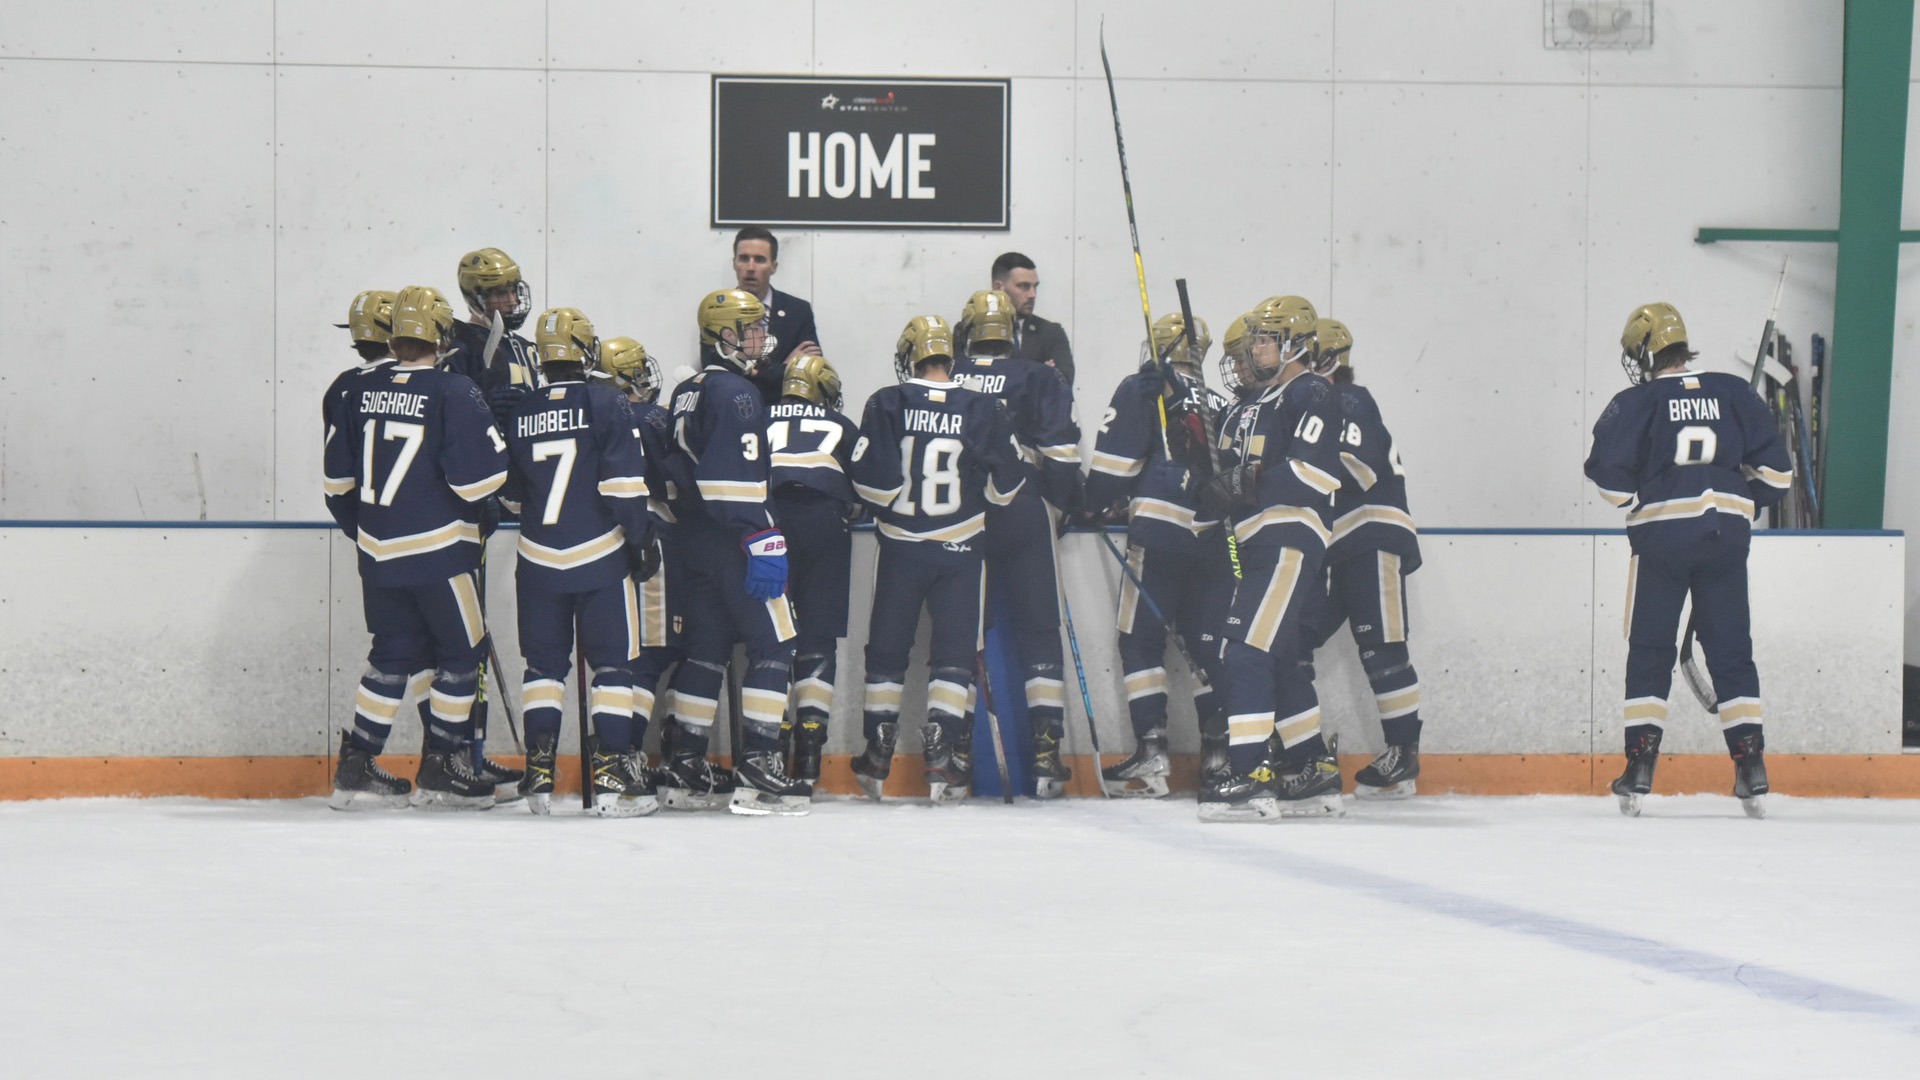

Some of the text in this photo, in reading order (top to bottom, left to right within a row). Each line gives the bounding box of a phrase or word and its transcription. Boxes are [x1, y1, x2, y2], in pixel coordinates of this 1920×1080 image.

[788, 131, 936, 199] HOME
[360, 391, 428, 418] SUGHRUE
[770, 404, 825, 418] HOGAN
[1668, 398, 1720, 421] BRYAN
[518, 408, 589, 438] HUBBELL
[766, 418, 843, 455] 17
[904, 409, 962, 434] VIRKAR
[1294, 410, 1324, 444] 10
[486, 425, 507, 454] 1
[741, 432, 759, 461] 3
[360, 419, 425, 507] 17
[891, 435, 964, 517] 18
[532, 438, 577, 525] 7
[1227, 535, 1243, 579] ALPHA
